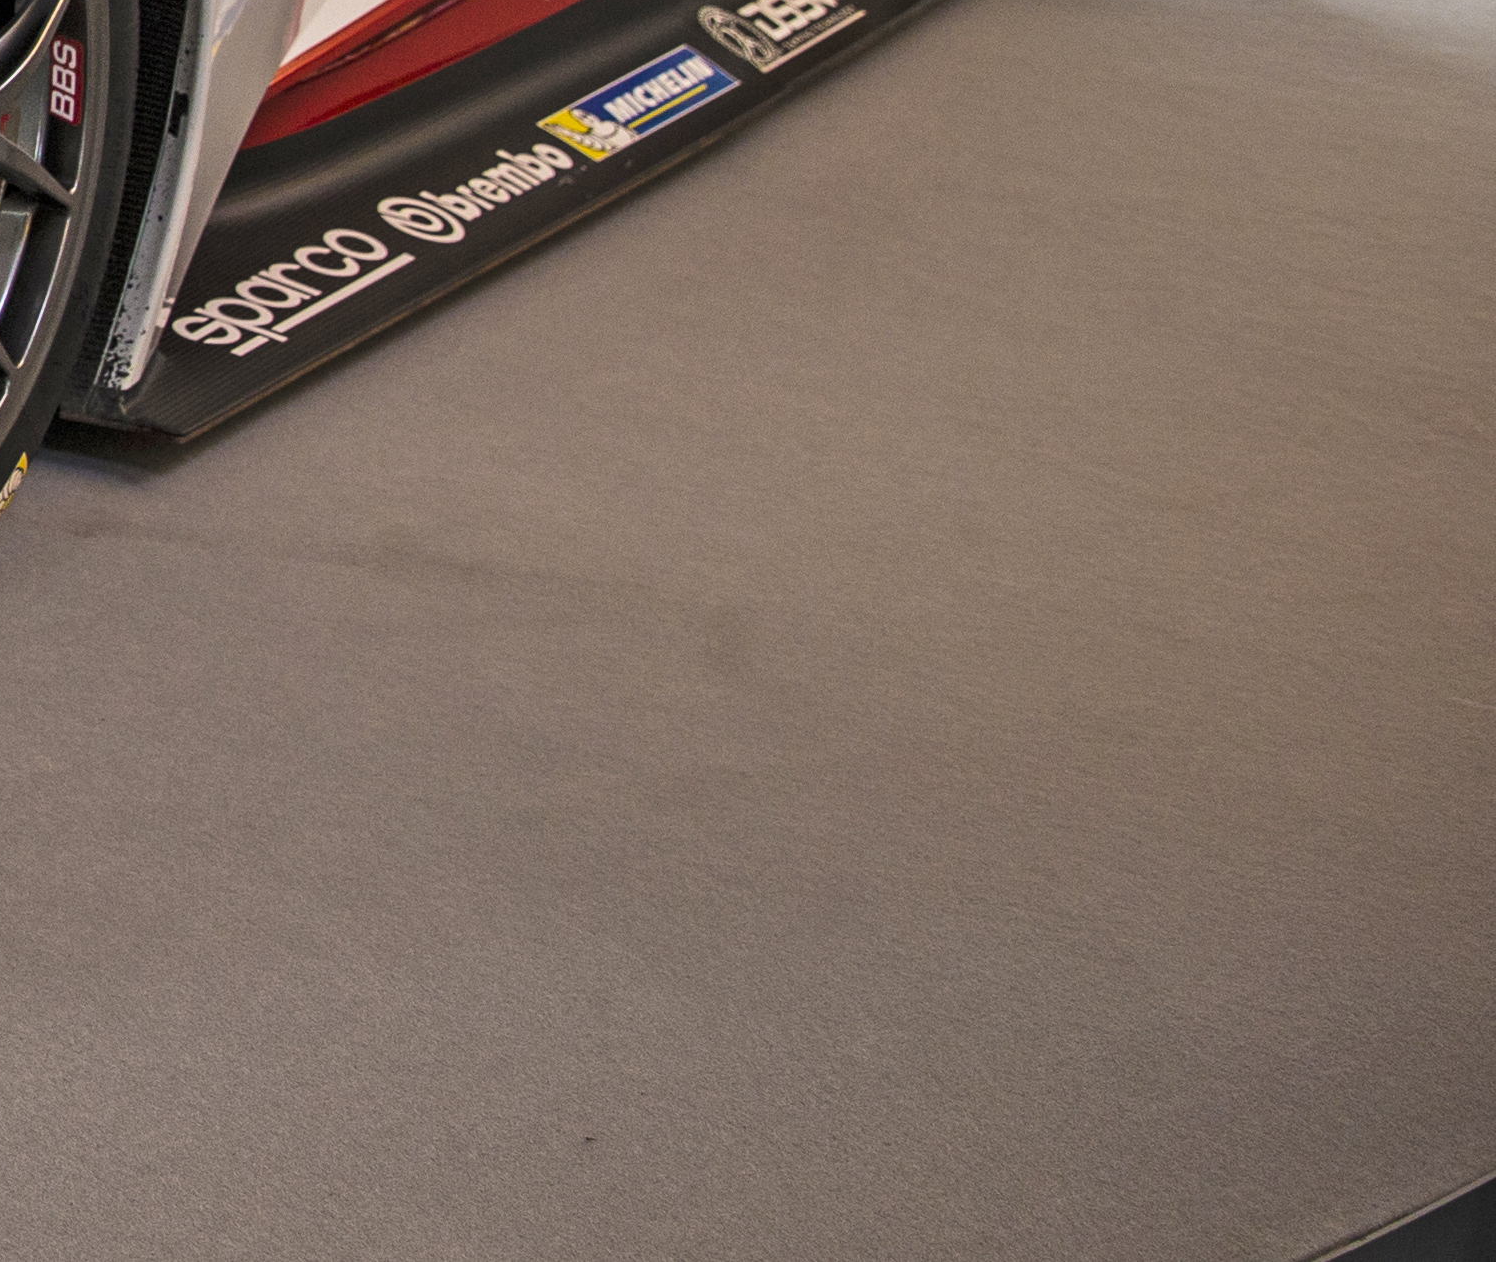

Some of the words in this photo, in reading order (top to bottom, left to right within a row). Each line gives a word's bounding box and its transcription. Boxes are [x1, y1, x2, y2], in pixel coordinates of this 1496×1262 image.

[50, 40, 78, 122] BBS
[603, 54, 715, 123] MICHELIN
[419, 142, 574, 222] brembo
[171, 227, 389, 356] sparco
